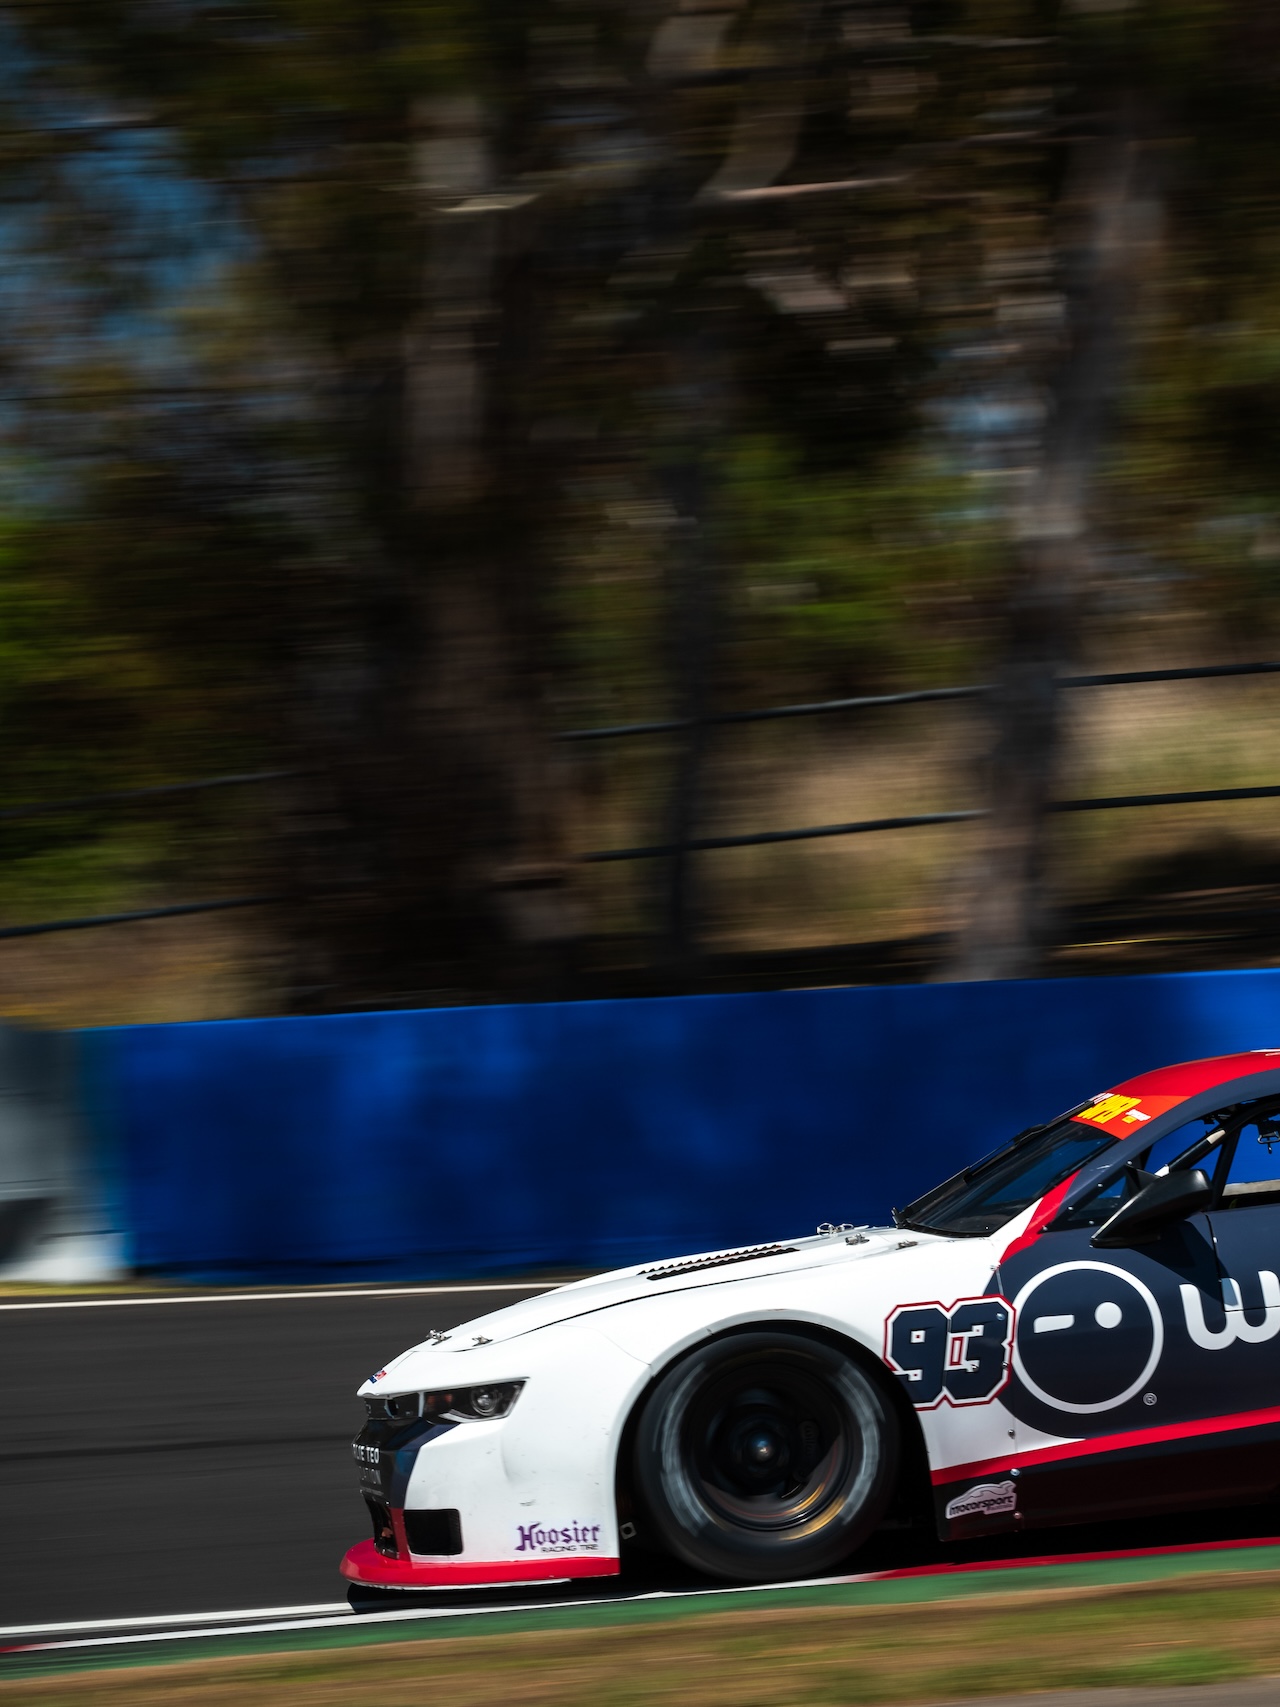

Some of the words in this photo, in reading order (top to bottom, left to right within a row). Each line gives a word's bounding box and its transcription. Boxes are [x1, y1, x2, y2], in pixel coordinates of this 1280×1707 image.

[884, 1294, 1016, 1412] 93
[366, 1446, 380, 1464] TEO
[515, 1520, 601, 1551] Hoosier
[540, 1545, 577, 1553] RACING
[580, 1543, 599, 1551] TIRE
